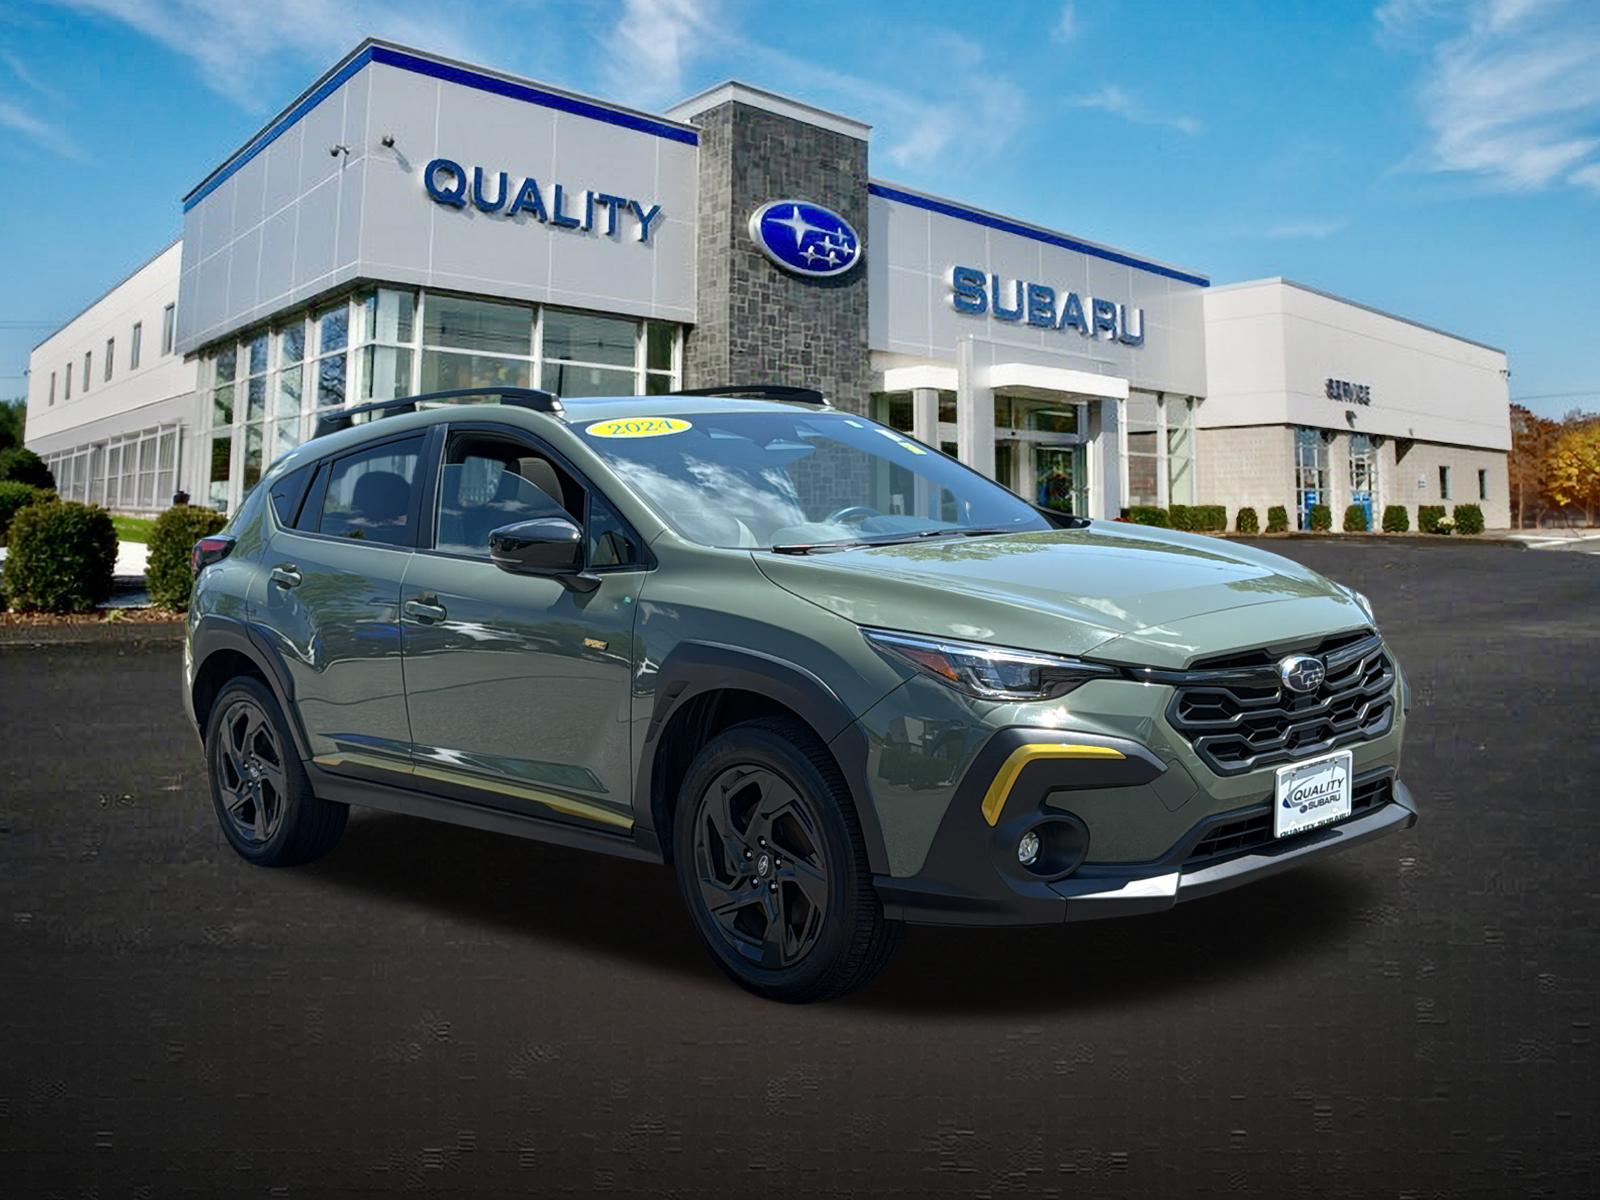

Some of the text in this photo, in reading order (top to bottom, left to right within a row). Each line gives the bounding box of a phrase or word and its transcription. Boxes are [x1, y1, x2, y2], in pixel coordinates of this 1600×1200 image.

[423, 158, 662, 242] QUALITY
[950, 264, 1145, 347] SUBARU
[607, 419, 673, 435] 2024
[1293, 777, 1345, 802] QUALITY
[1308, 793, 1341, 810] SUBARU
